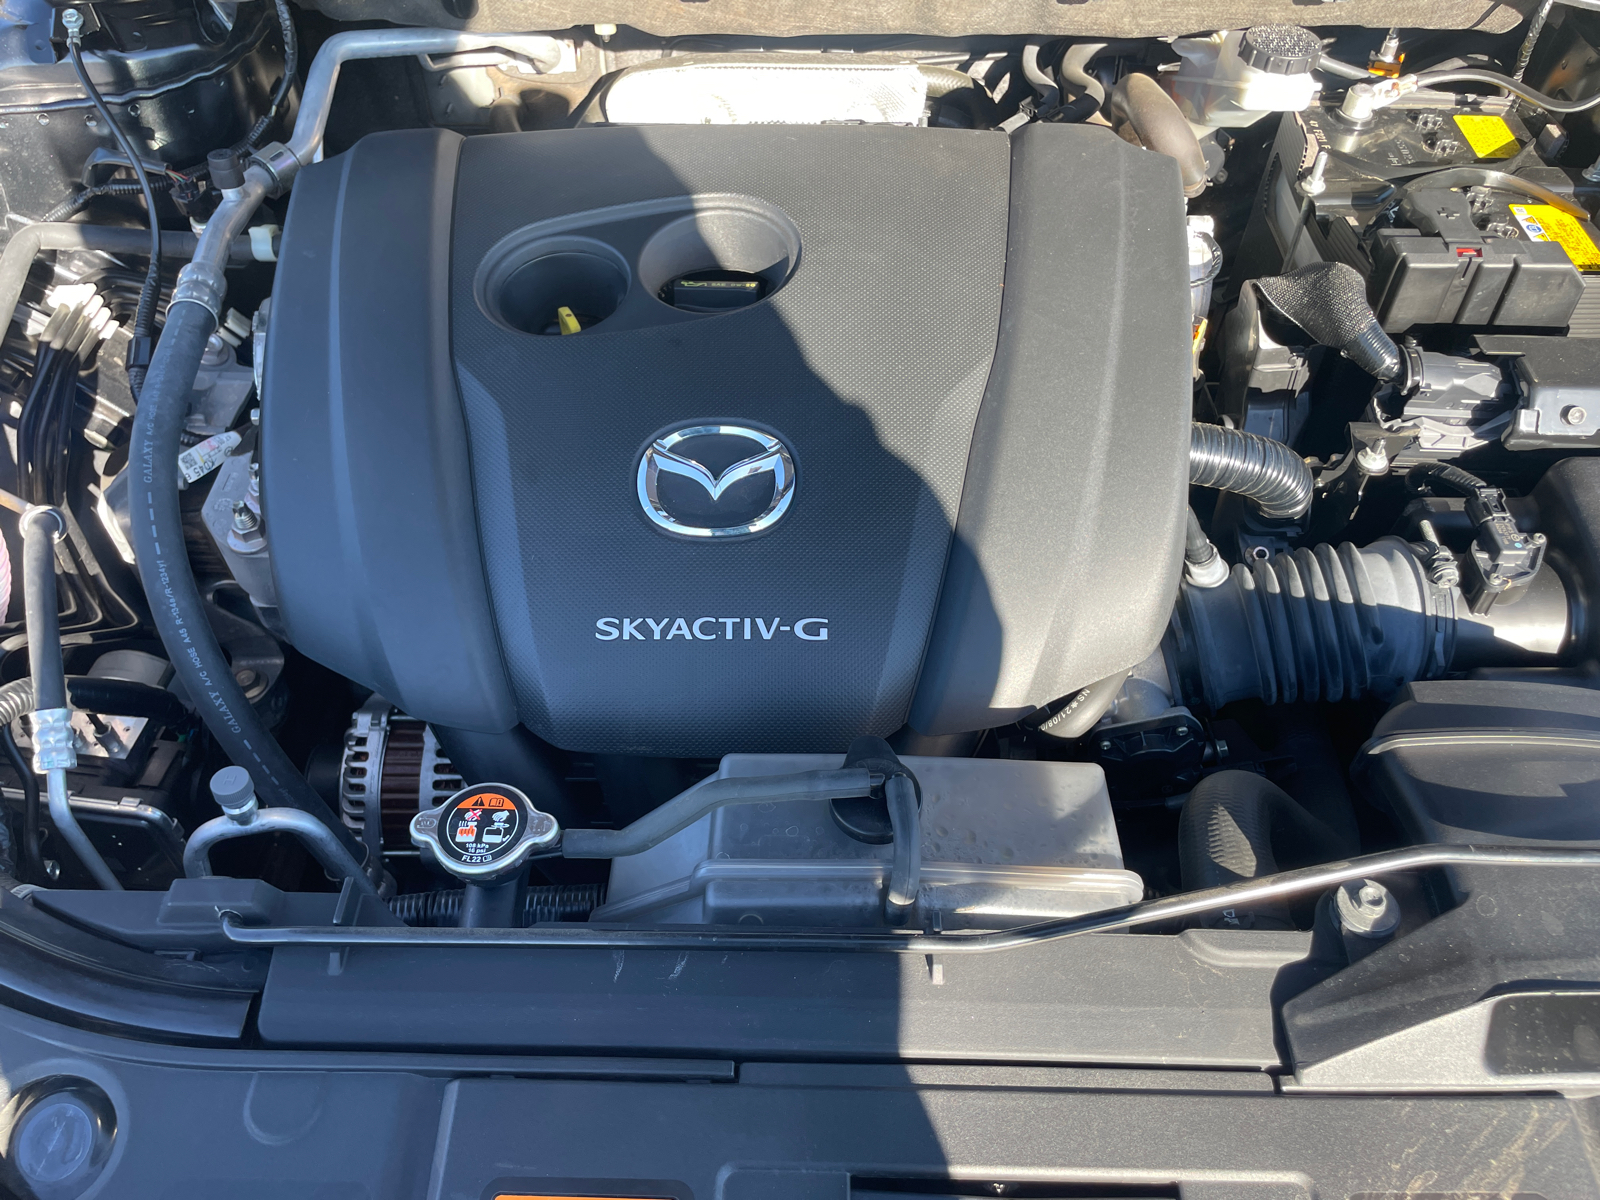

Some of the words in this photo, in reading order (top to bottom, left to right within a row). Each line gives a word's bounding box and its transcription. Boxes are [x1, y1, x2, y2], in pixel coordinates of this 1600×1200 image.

[143, 440, 153, 484] GALAXY
[179, 628, 191, 643] A45
[595, 616, 829, 641] SKYACTIV-G
[187, 646, 203, 669] HOSE
[200, 670, 213, 686] A/C
[208, 691, 241, 734] GALAXY
